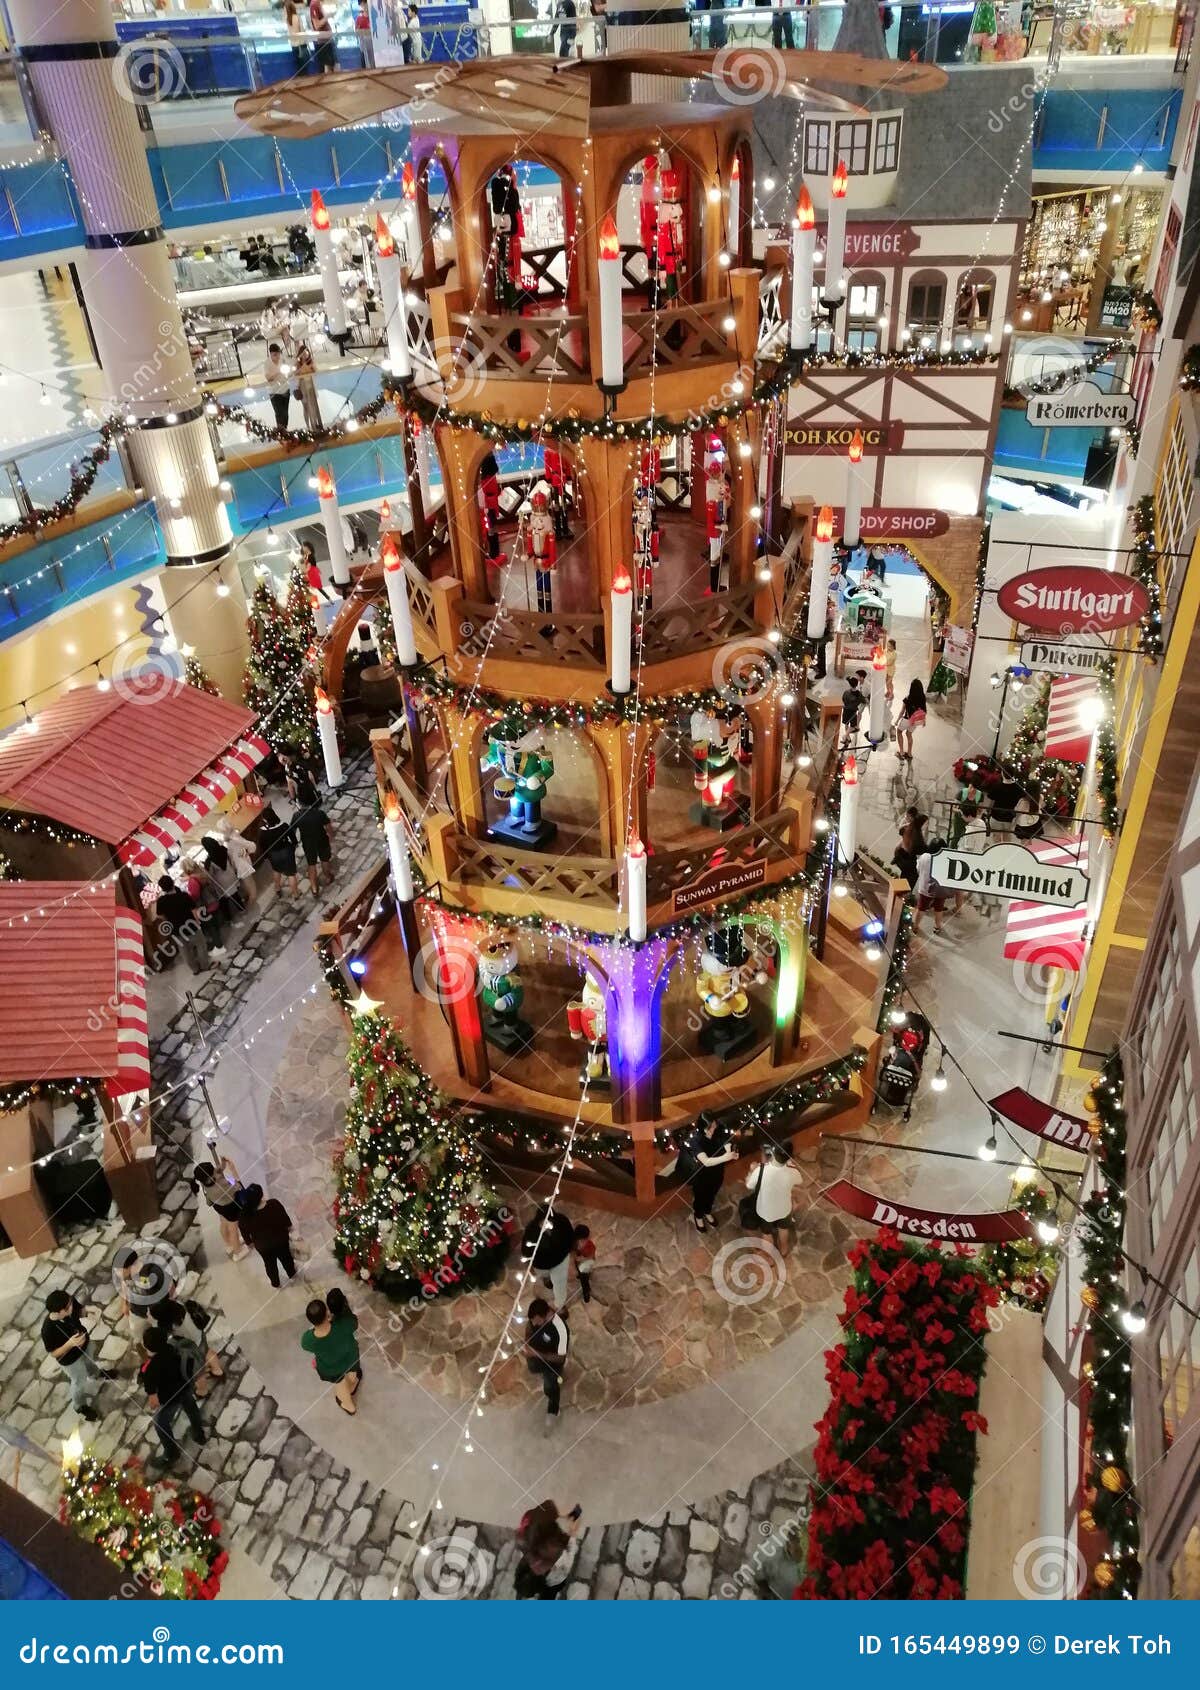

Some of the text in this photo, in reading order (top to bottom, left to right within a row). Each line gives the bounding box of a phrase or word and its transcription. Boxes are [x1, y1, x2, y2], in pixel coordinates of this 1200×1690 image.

[840, 234, 901, 253] EVENGE
[1103, 305, 1130, 316] RM20
[1036, 402, 1129, 422] Römerberg
[783, 430, 820, 445] POH
[858, 515, 937, 531] ODY SHOP
[1014, 582, 1134, 618] Stuttgart
[946, 857, 1074, 898] Dortmund
[872, 1201, 977, 1238] Dresden
